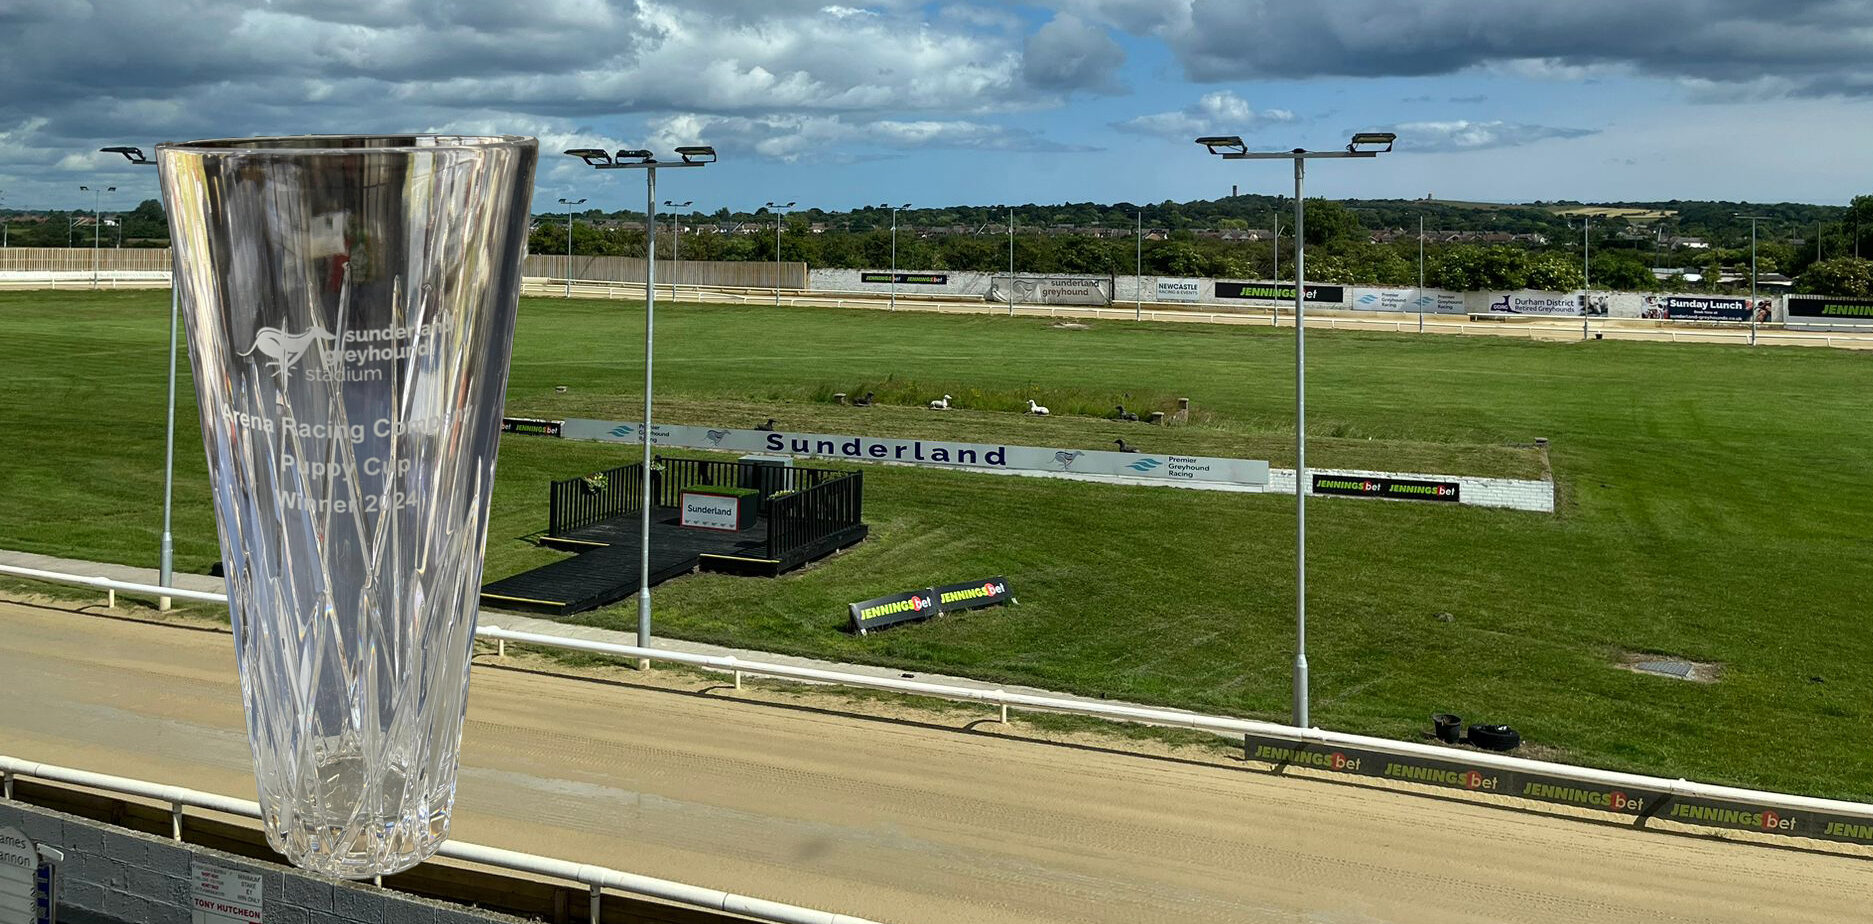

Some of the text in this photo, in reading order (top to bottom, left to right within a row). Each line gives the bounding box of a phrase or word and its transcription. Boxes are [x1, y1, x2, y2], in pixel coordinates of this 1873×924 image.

[1051, 279, 1100, 288] sunderland
[1158, 283, 1198, 291] NEWCASTLE
[1042, 288, 1089, 298] greyhound
[1515, 298, 1575, 307] Durham District
[1670, 300, 1743, 311] Sunday Lunch
[345, 317, 453, 342] sunderand
[305, 366, 382, 382] stadium
[222, 402, 274, 433] Arena
[281, 416, 365, 443] Racing
[766, 433, 1007, 466] Sunderland
[281, 454, 412, 481] Puppy Cup
[1168, 456, 1196, 464] Premier
[1168, 463, 1210, 472] Greyhound
[1168, 470, 1193, 478] Racing
[1317, 480, 1381, 491] JENNINGSbet
[1389, 484, 1455, 496] JENNINGSbet
[687, 504, 732, 516] Sunderland
[940, 583, 1005, 604] JENNINGSbet
[861, 597, 931, 620] JENNINGSbet
[1255, 745, 1361, 770] JENNINGSbet
[1382, 762, 1499, 790] JENNINGSbet
[1523, 782, 1644, 811] JENNINGSbet
[1671, 803, 1797, 832] JENNINGSbet
[194, 898, 261, 918] TONY HUTCHEON
